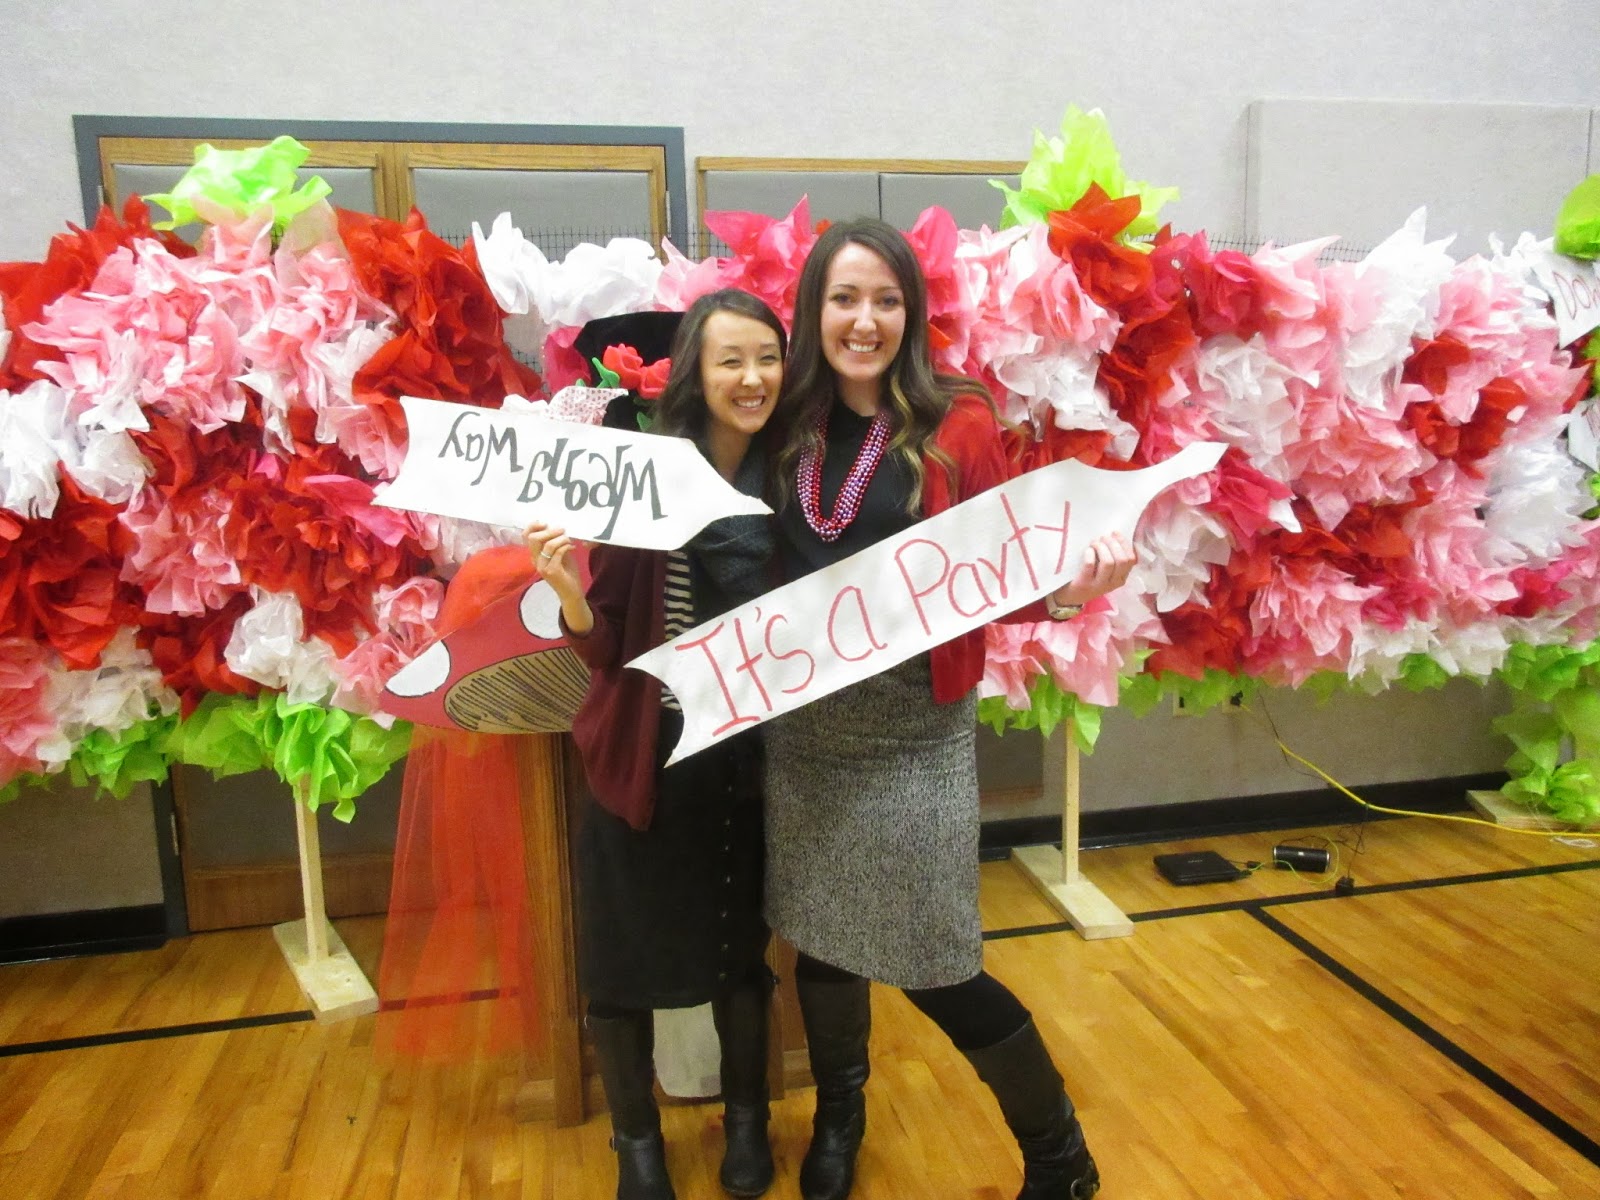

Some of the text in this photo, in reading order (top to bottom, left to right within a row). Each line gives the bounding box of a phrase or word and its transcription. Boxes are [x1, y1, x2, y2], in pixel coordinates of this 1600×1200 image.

[437, 411, 669, 541] Wrong Way
[674, 492, 1071, 737] It's a Party
